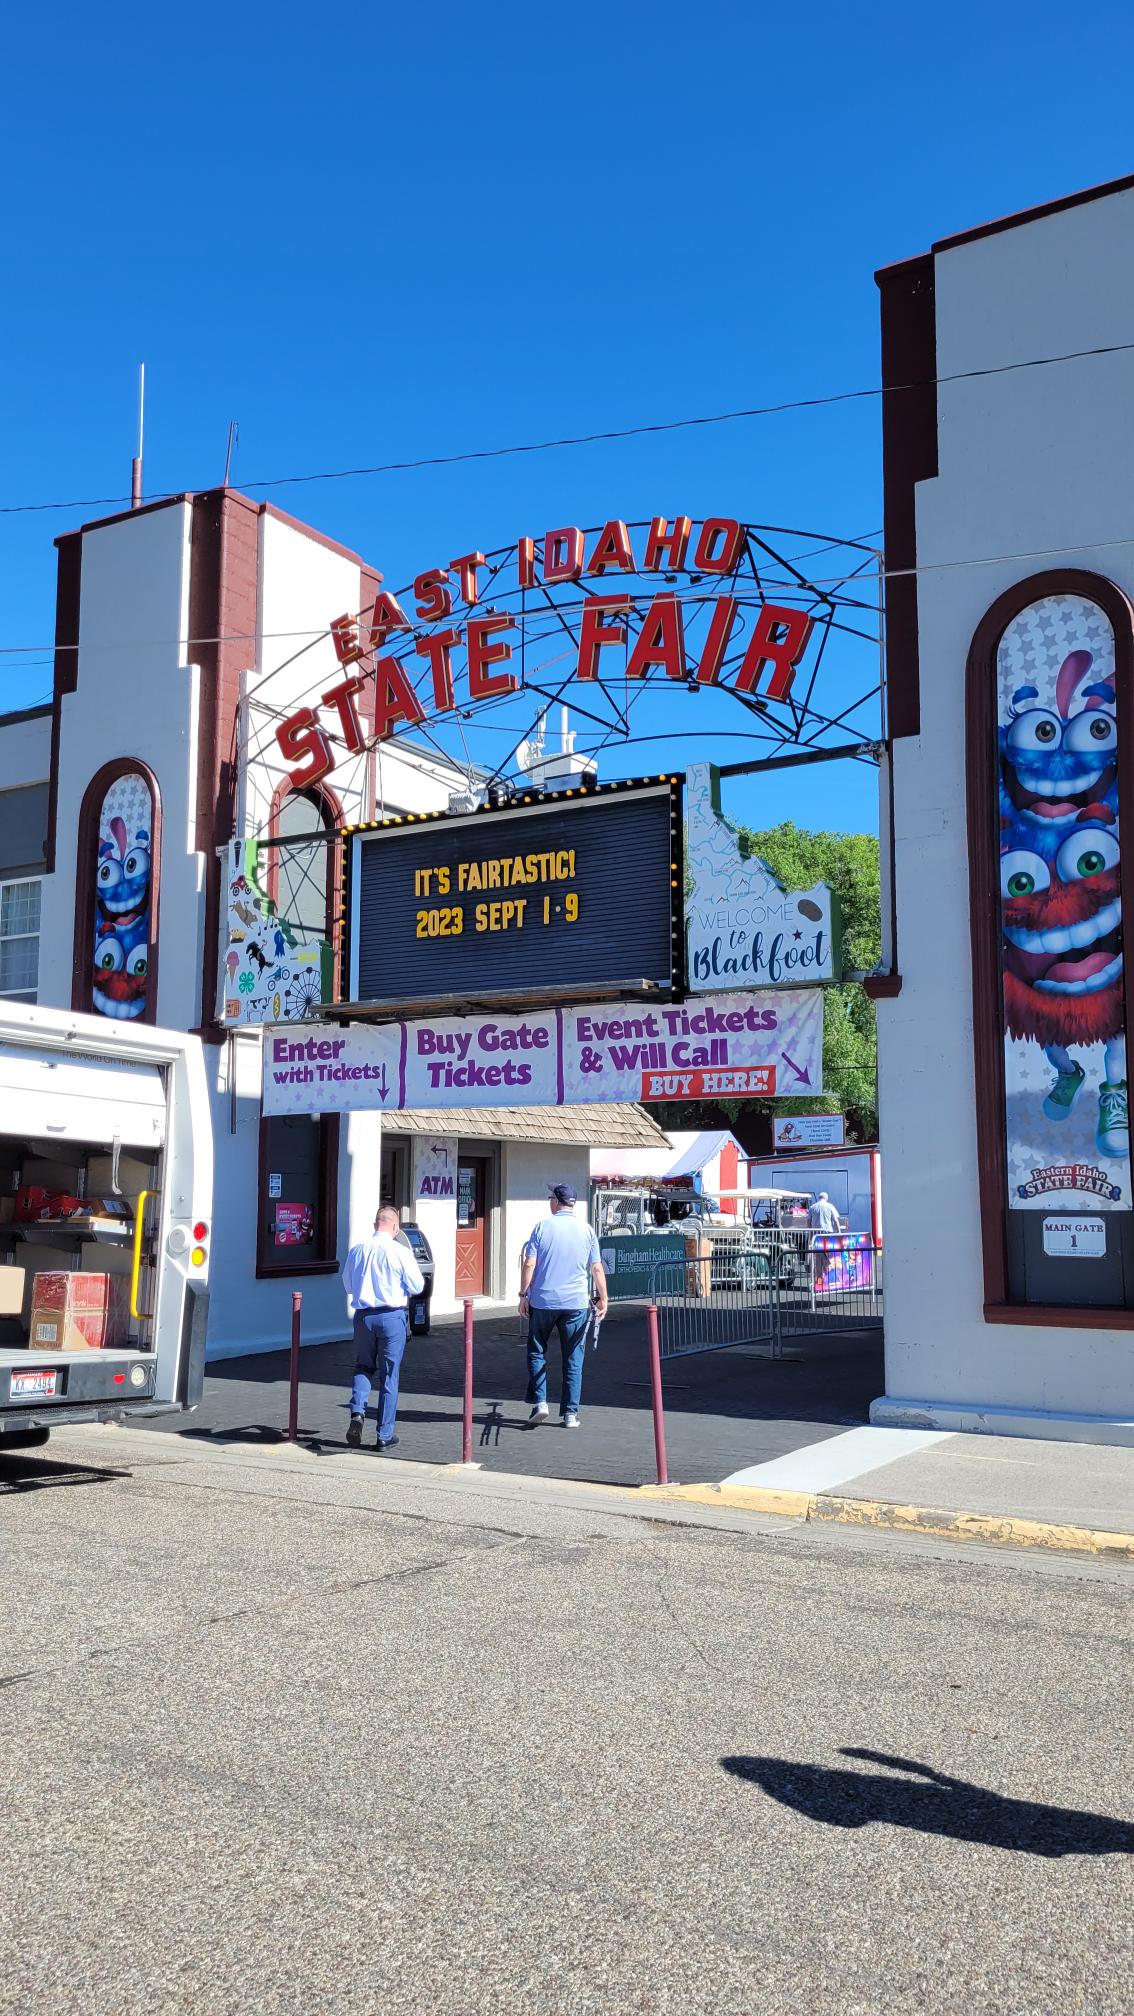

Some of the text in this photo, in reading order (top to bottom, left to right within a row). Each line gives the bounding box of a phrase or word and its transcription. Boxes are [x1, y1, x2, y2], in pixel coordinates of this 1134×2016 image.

[329, 515, 747, 665] EAST IDAHO
[276, 592, 814, 788] STATE FAIR
[415, 849, 575, 896] IT'S FAIRTASTIC!
[416, 906, 463, 938] 2023
[475, 899, 527, 932] SEPT
[699, 903, 794, 930] WELCOME
[729, 930, 751, 949] to
[693, 930, 830, 982] Blackfoot
[576, 1005, 778, 1042] Event Tickets
[273, 1036, 346, 1063] Enter
[416, 1023, 549, 1061] Buy Gate
[579, 1038, 729, 1073] & Will Call
[273, 1062, 380, 1084] with Tickets
[427, 1059, 532, 1088] Tickets
[649, 1070, 770, 1096] BUY HERE!
[420, 1175, 454, 1195] ATM
[1031, 1165, 1106, 1180] Eastern Idaho
[1025, 1175, 1114, 1198] STATE FAIR
[1044, 1223, 1104, 1233] MAIN GATE
[1070, 1234, 1078, 1248] 1
[617, 1246, 684, 1265] Bingham Healthcare
